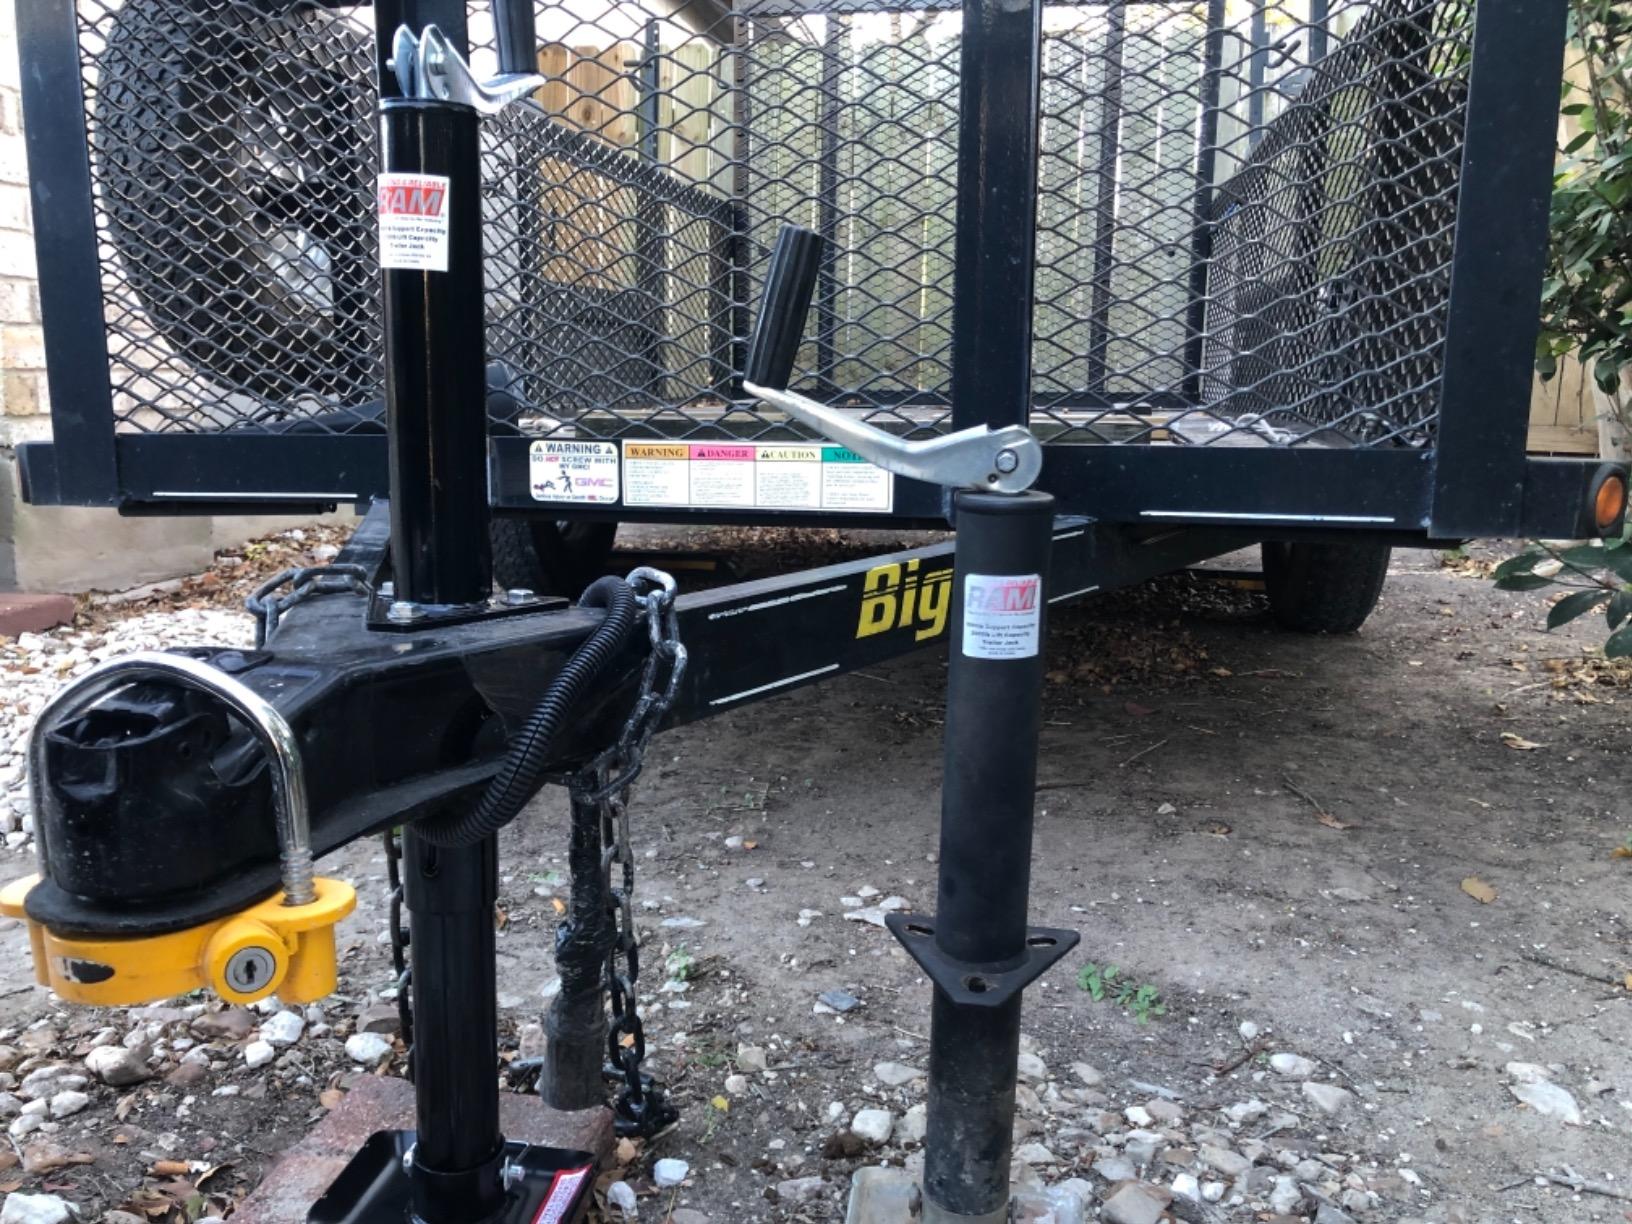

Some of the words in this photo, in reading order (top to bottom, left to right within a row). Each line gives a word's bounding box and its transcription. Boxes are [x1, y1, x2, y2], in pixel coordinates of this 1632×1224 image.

[378, 187, 445, 217] RAM
[546, 443, 601, 455] WARNING
[631, 447, 683, 457] WARNING
[707, 450, 749, 458] DANGER
[770, 450, 816, 459] CAUTION
[561, 456, 592, 464] SCREW
[575, 477, 613, 488] GMC
[856, 558, 954, 642] Big
[968, 585, 1036, 610] RAM
